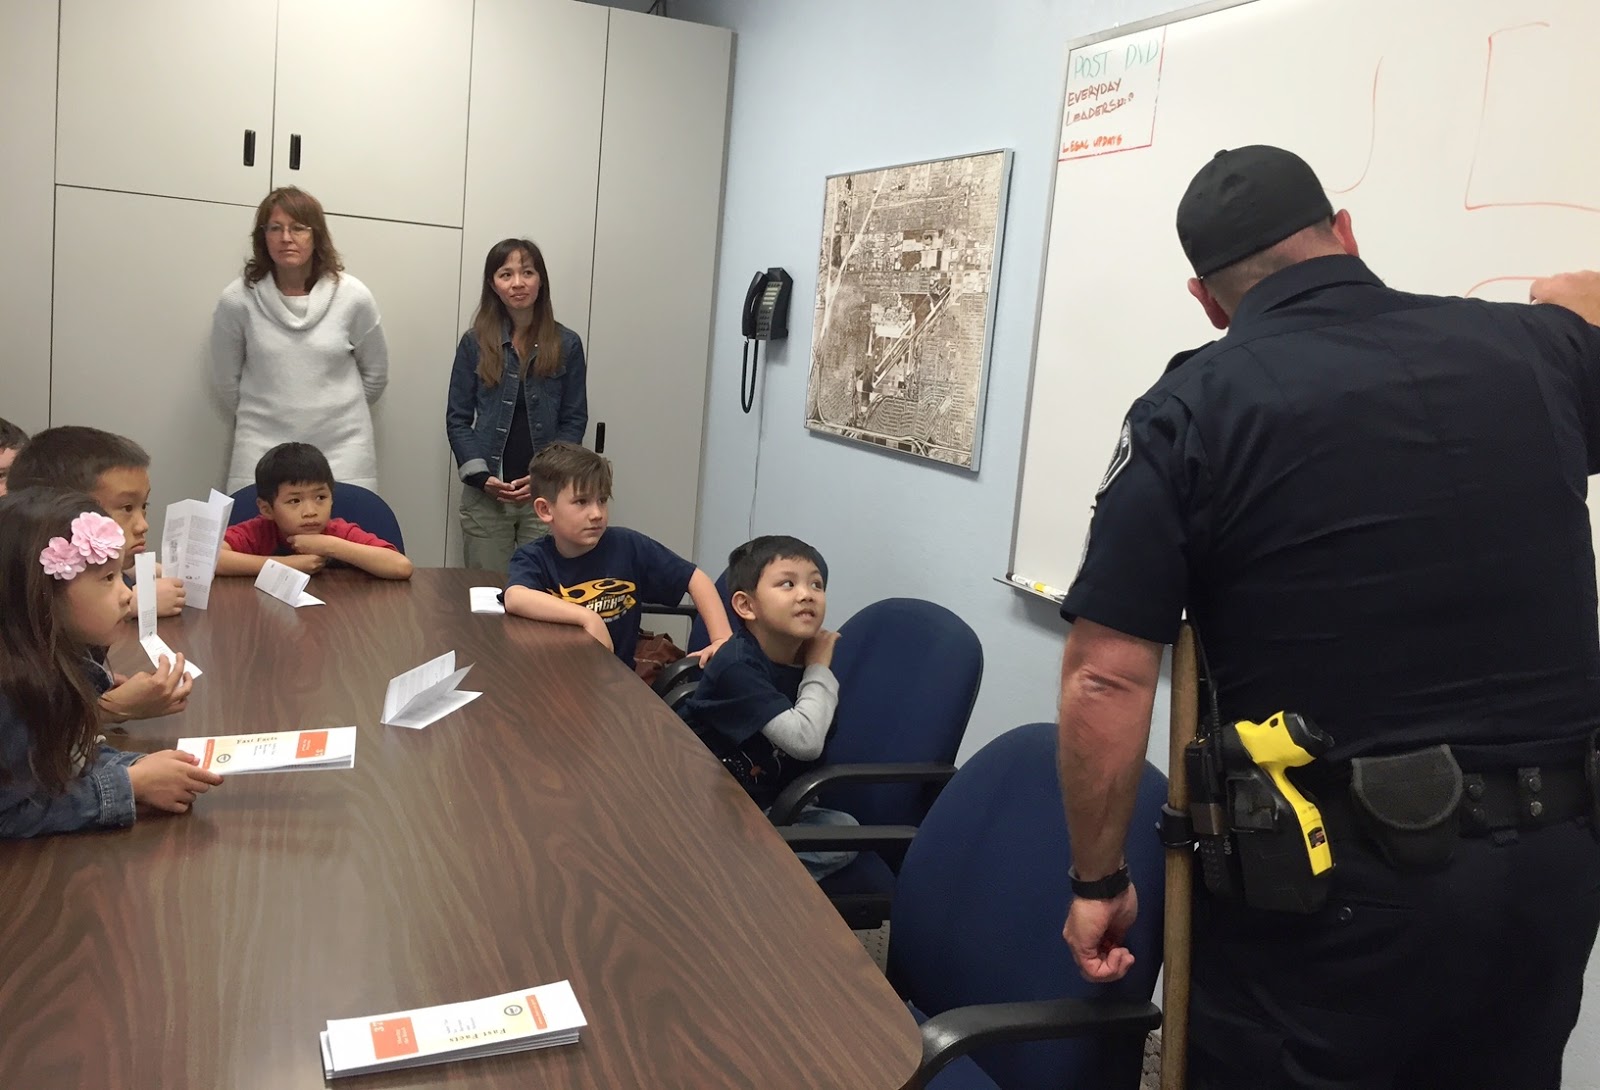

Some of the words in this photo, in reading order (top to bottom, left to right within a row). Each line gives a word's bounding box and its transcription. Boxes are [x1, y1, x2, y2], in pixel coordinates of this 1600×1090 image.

[1074, 49, 1113, 79] POST
[1125, 38, 1159, 71] DVD
[1067, 77, 1122, 107] EVERYDAY
